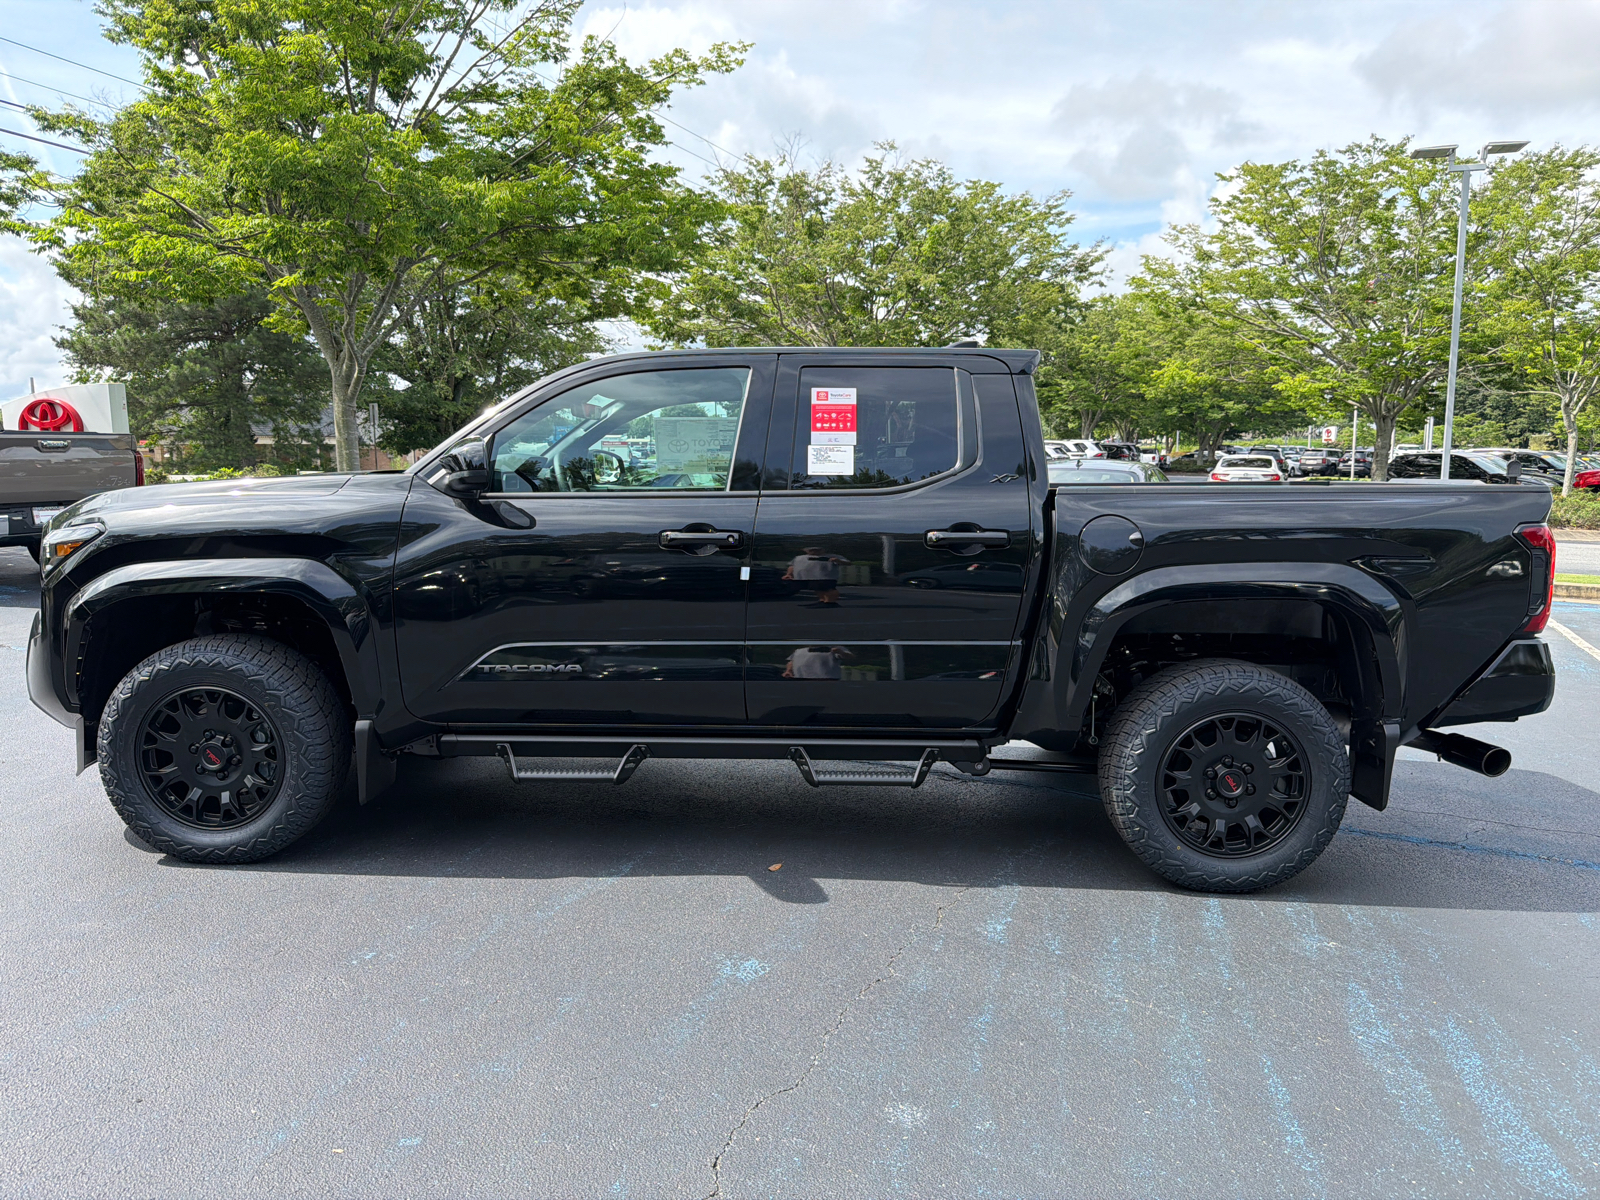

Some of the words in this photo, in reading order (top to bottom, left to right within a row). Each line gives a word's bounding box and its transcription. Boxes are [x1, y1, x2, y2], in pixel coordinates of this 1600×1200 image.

[477, 664, 583, 673] TACOMA
[206, 749, 221, 765] TRD
[1225, 775, 1238, 792] TRD
